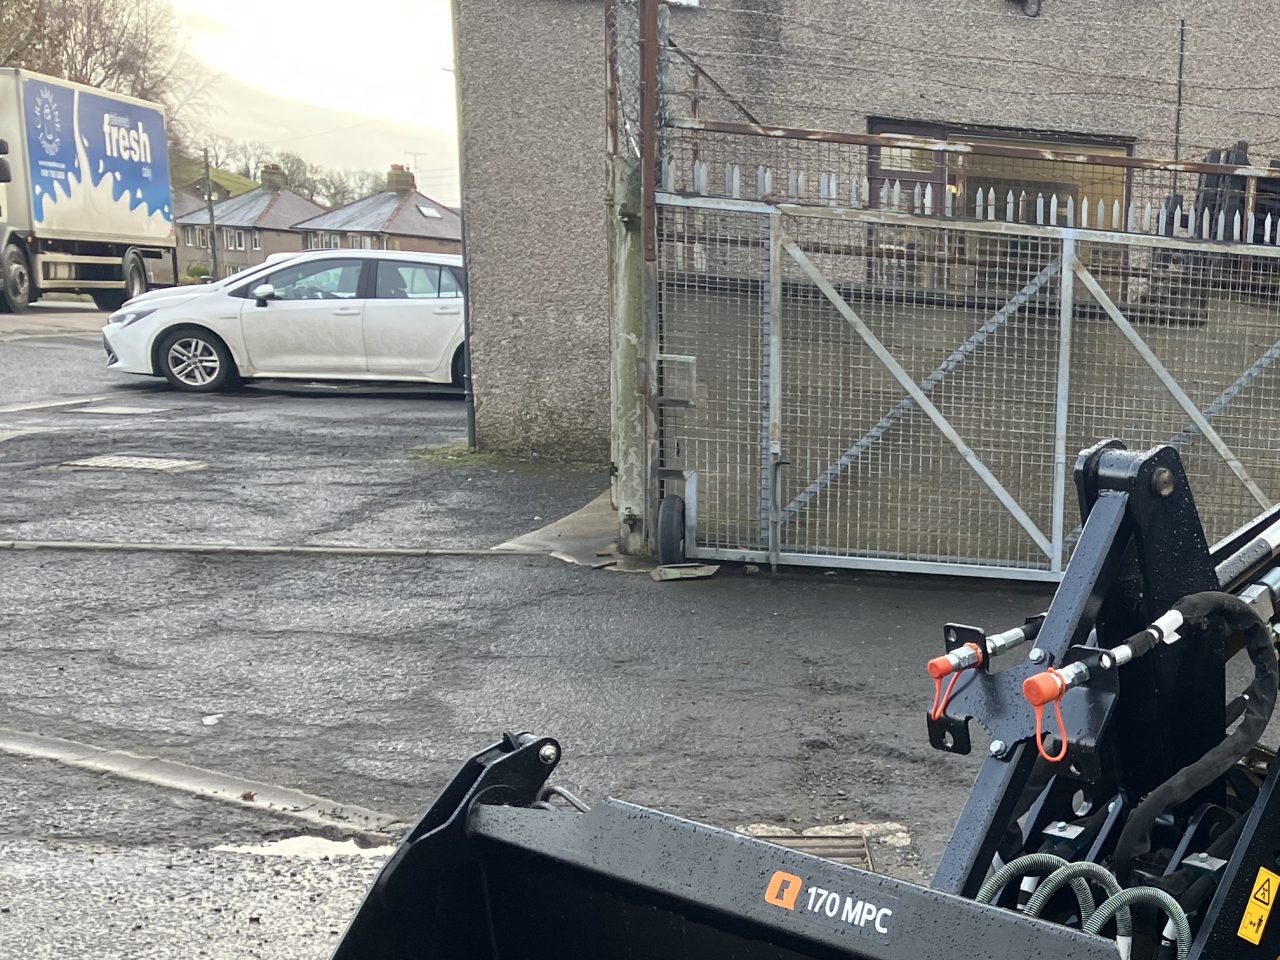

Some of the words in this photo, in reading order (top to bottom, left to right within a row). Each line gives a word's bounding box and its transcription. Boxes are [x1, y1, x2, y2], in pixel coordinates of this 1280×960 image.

[103, 113, 151, 163] fresh
[807, 886, 841, 918] 170
[841, 896, 893, 934] MPC
